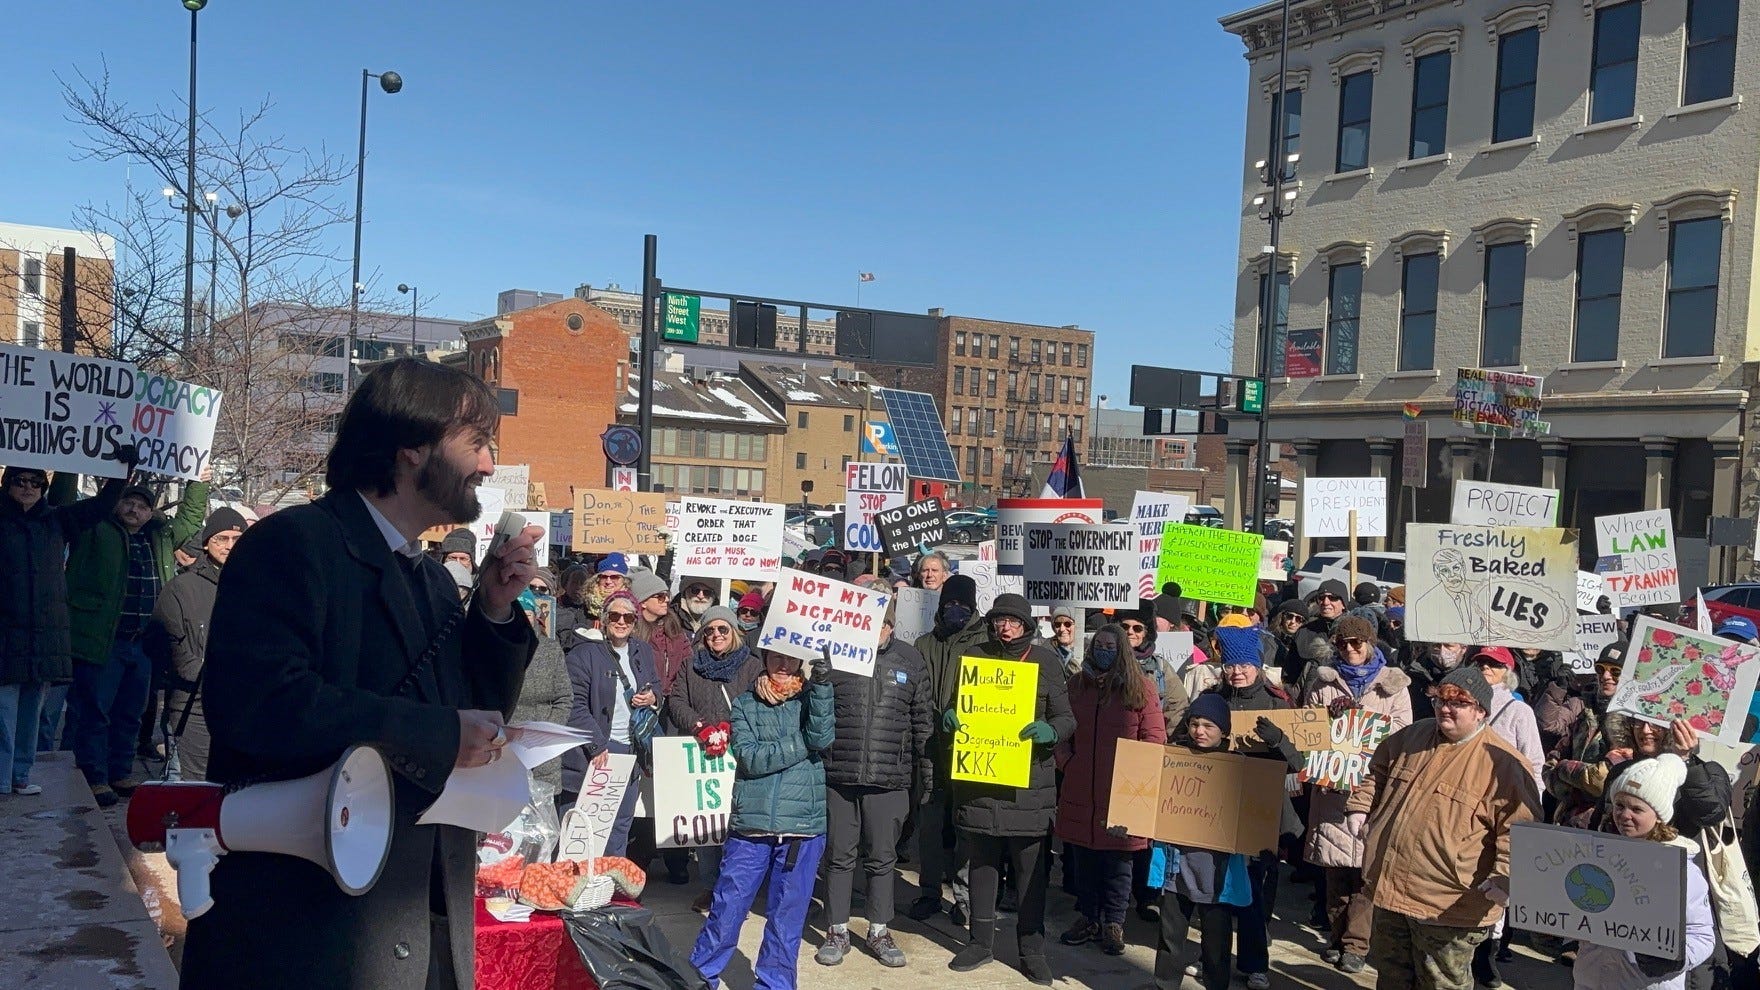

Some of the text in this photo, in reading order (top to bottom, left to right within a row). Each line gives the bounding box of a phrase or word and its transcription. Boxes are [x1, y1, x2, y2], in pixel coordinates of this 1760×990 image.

[668, 295, 688, 307] Ninth
[668, 305, 689, 317] Street
[666, 315, 687, 326] West
[0, 352, 134, 399] HE WORLD
[1457, 367, 1537, 388] REAL LEADERS
[44, 391, 71, 422] IS
[1455, 389, 1478, 402] ACT
[1454, 409, 1474, 422] THE
[1456, 399, 1518, 418] DICTATORS
[82, 424, 123, 461] US
[871, 424, 885, 443] P
[131, 434, 209, 477] CRACY
[847, 464, 906, 491] FELON
[1315, 479, 1386, 493] CONVICT
[527, 494, 545, 507] ING
[638, 503, 657, 516] THE
[686, 502, 718, 515] REVOKE
[728, 505, 773, 516] EXECUTIVE
[859, 493, 887, 512] STOP
[1136, 503, 1170, 519] MAKE
[1310, 495, 1386, 513] PRESIDENT
[1467, 488, 1557, 519] PROTECT
[583, 512, 612, 527] Eric
[697, 518, 756, 529] ORDER THAT
[863, 512, 879, 526] TH
[880, 499, 938, 527] NO ONE
[907, 517, 940, 533] above
[1166, 523, 1265, 547] IMPEACH THE FELON
[1601, 514, 1665, 536] Where
[582, 529, 615, 545] Ivanka
[684, 532, 758, 543] CREATED DOGE
[892, 528, 944, 552] the LAW
[1000, 538, 1019, 551] THE
[1029, 529, 1134, 551] STOP THE GOVERNMENT
[1177, 537, 1262, 558] INSURRECTIONIST
[1437, 528, 1526, 559] Freshly
[1612, 528, 1667, 554] LAW
[695, 546, 746, 555] ELON MUSK
[686, 556, 780, 569] HAS GOT TO GO NOW!
[1051, 555, 1120, 577] TAKEOVER BY
[1468, 555, 1546, 577] Baked
[1622, 551, 1672, 575] ENDS
[1026, 580, 1076, 601] PRESIDENT
[1606, 567, 1677, 593] TYRANNY
[791, 576, 868, 608] NOT MY
[1618, 589, 1672, 607] Begins
[785, 599, 873, 632] DICTATOR
[1490, 586, 1550, 630] LIES
[811, 620, 832, 633] (OR
[774, 626, 875, 665] PRESIDENT)
[1582, 641, 1600, 651] the
[960, 664, 1017, 687] MuskRat
[960, 693, 1017, 716] Unelected
[1293, 710, 1317, 724] NO
[956, 723, 1021, 749] Segregation
[955, 749, 998, 778] KKK
[1162, 755, 1214, 774] Democracy
[586, 765, 613, 797] NOT
[1169, 775, 1206, 798] NOT
[695, 778, 722, 811] IS
[592, 774, 629, 839] A CRIME
[673, 813, 726, 846] COU
[1533, 841, 1605, 873] CLIMATE
[1514, 904, 1528, 924] IS
[1535, 910, 1570, 930] NOT
[1577, 915, 1592, 934] A
